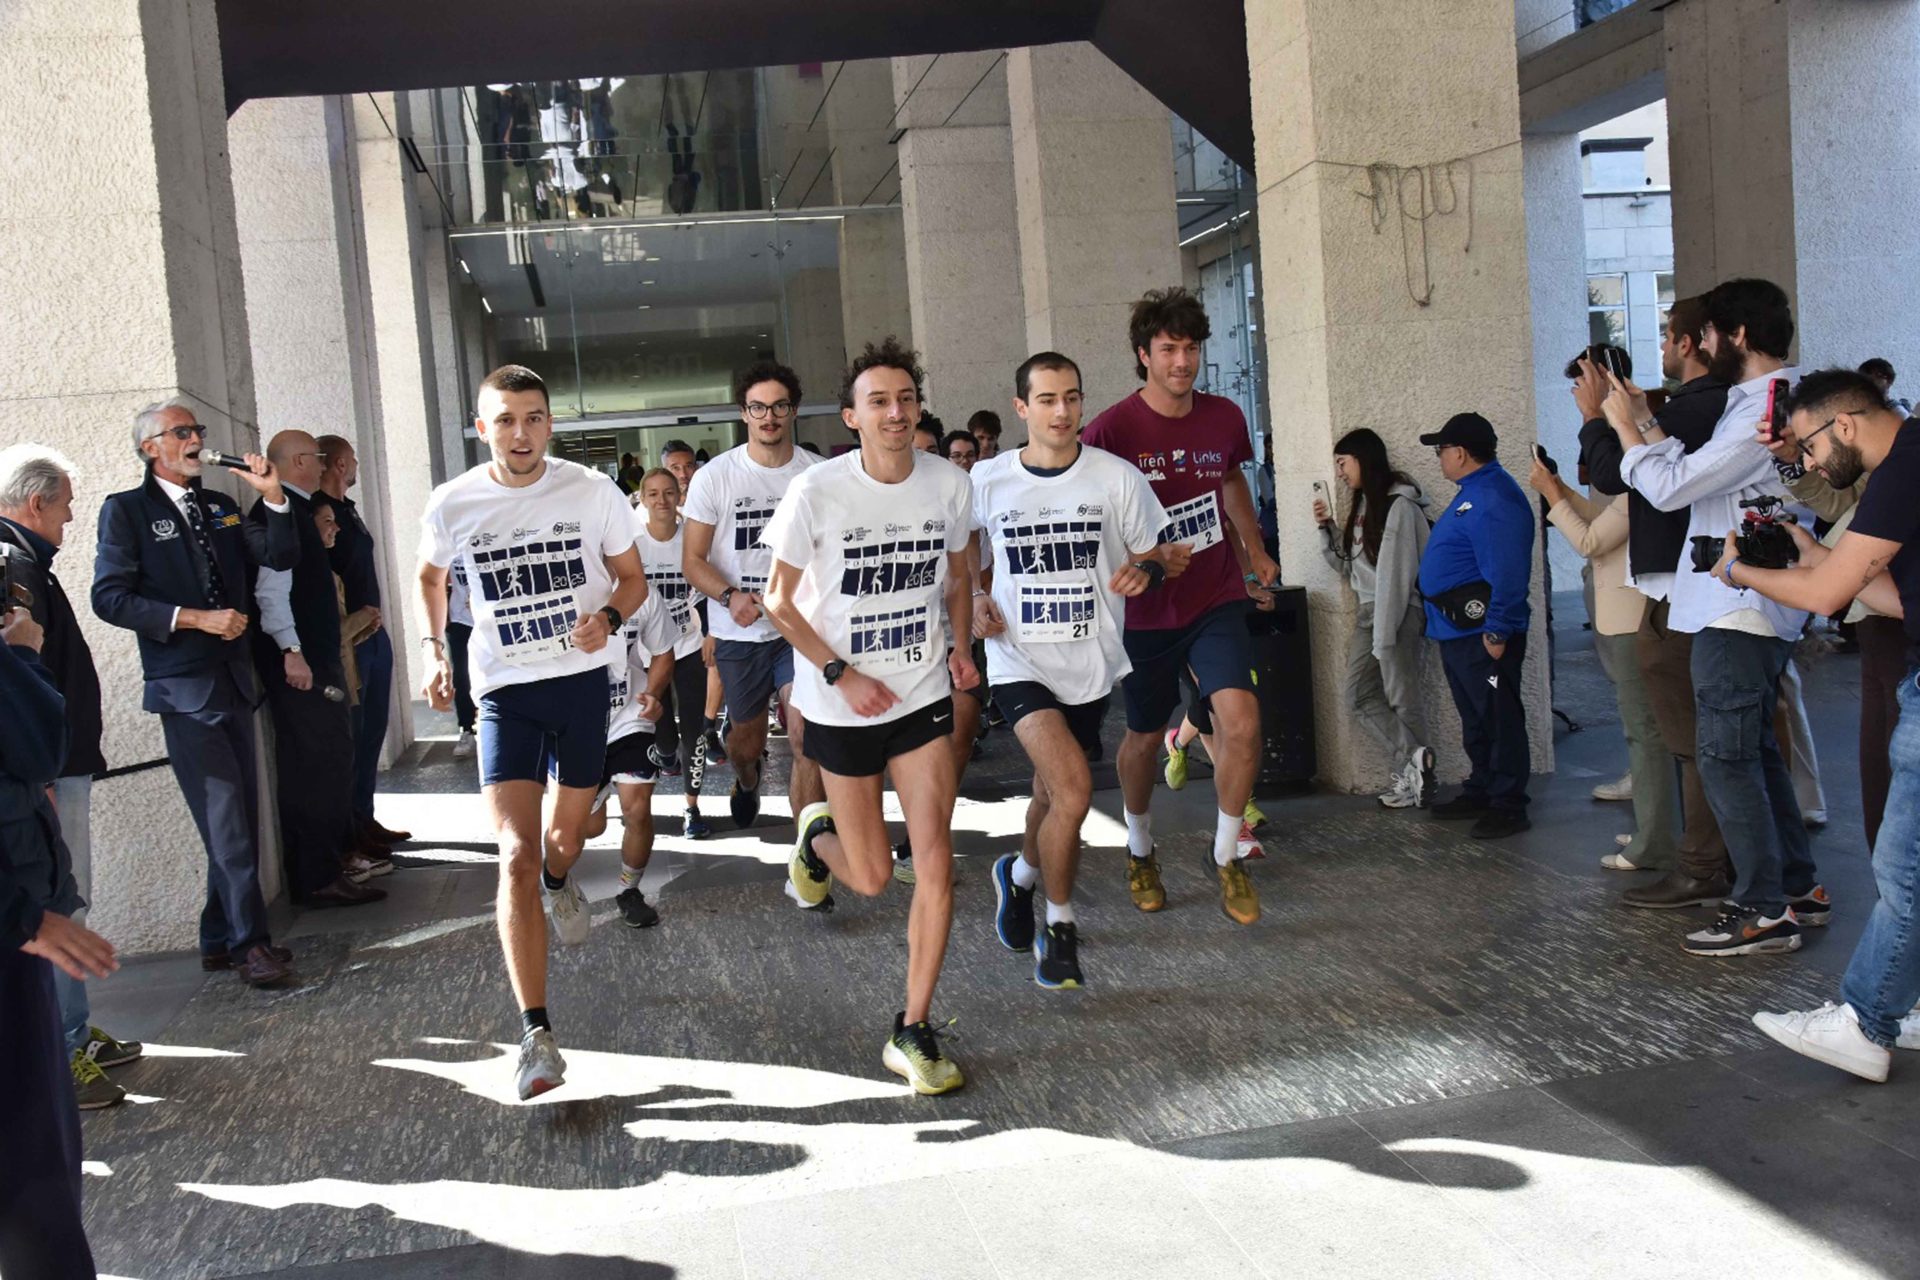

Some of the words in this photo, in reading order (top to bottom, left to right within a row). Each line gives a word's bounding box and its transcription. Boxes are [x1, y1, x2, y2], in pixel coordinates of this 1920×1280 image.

[1138, 454, 1166, 468] iren
[1193, 450, 1222, 464] Links
[1205, 531, 1213, 544] 2
[1072, 623, 1088, 638] 21
[904, 646, 923, 663] 15
[690, 735, 707, 789] adidas
